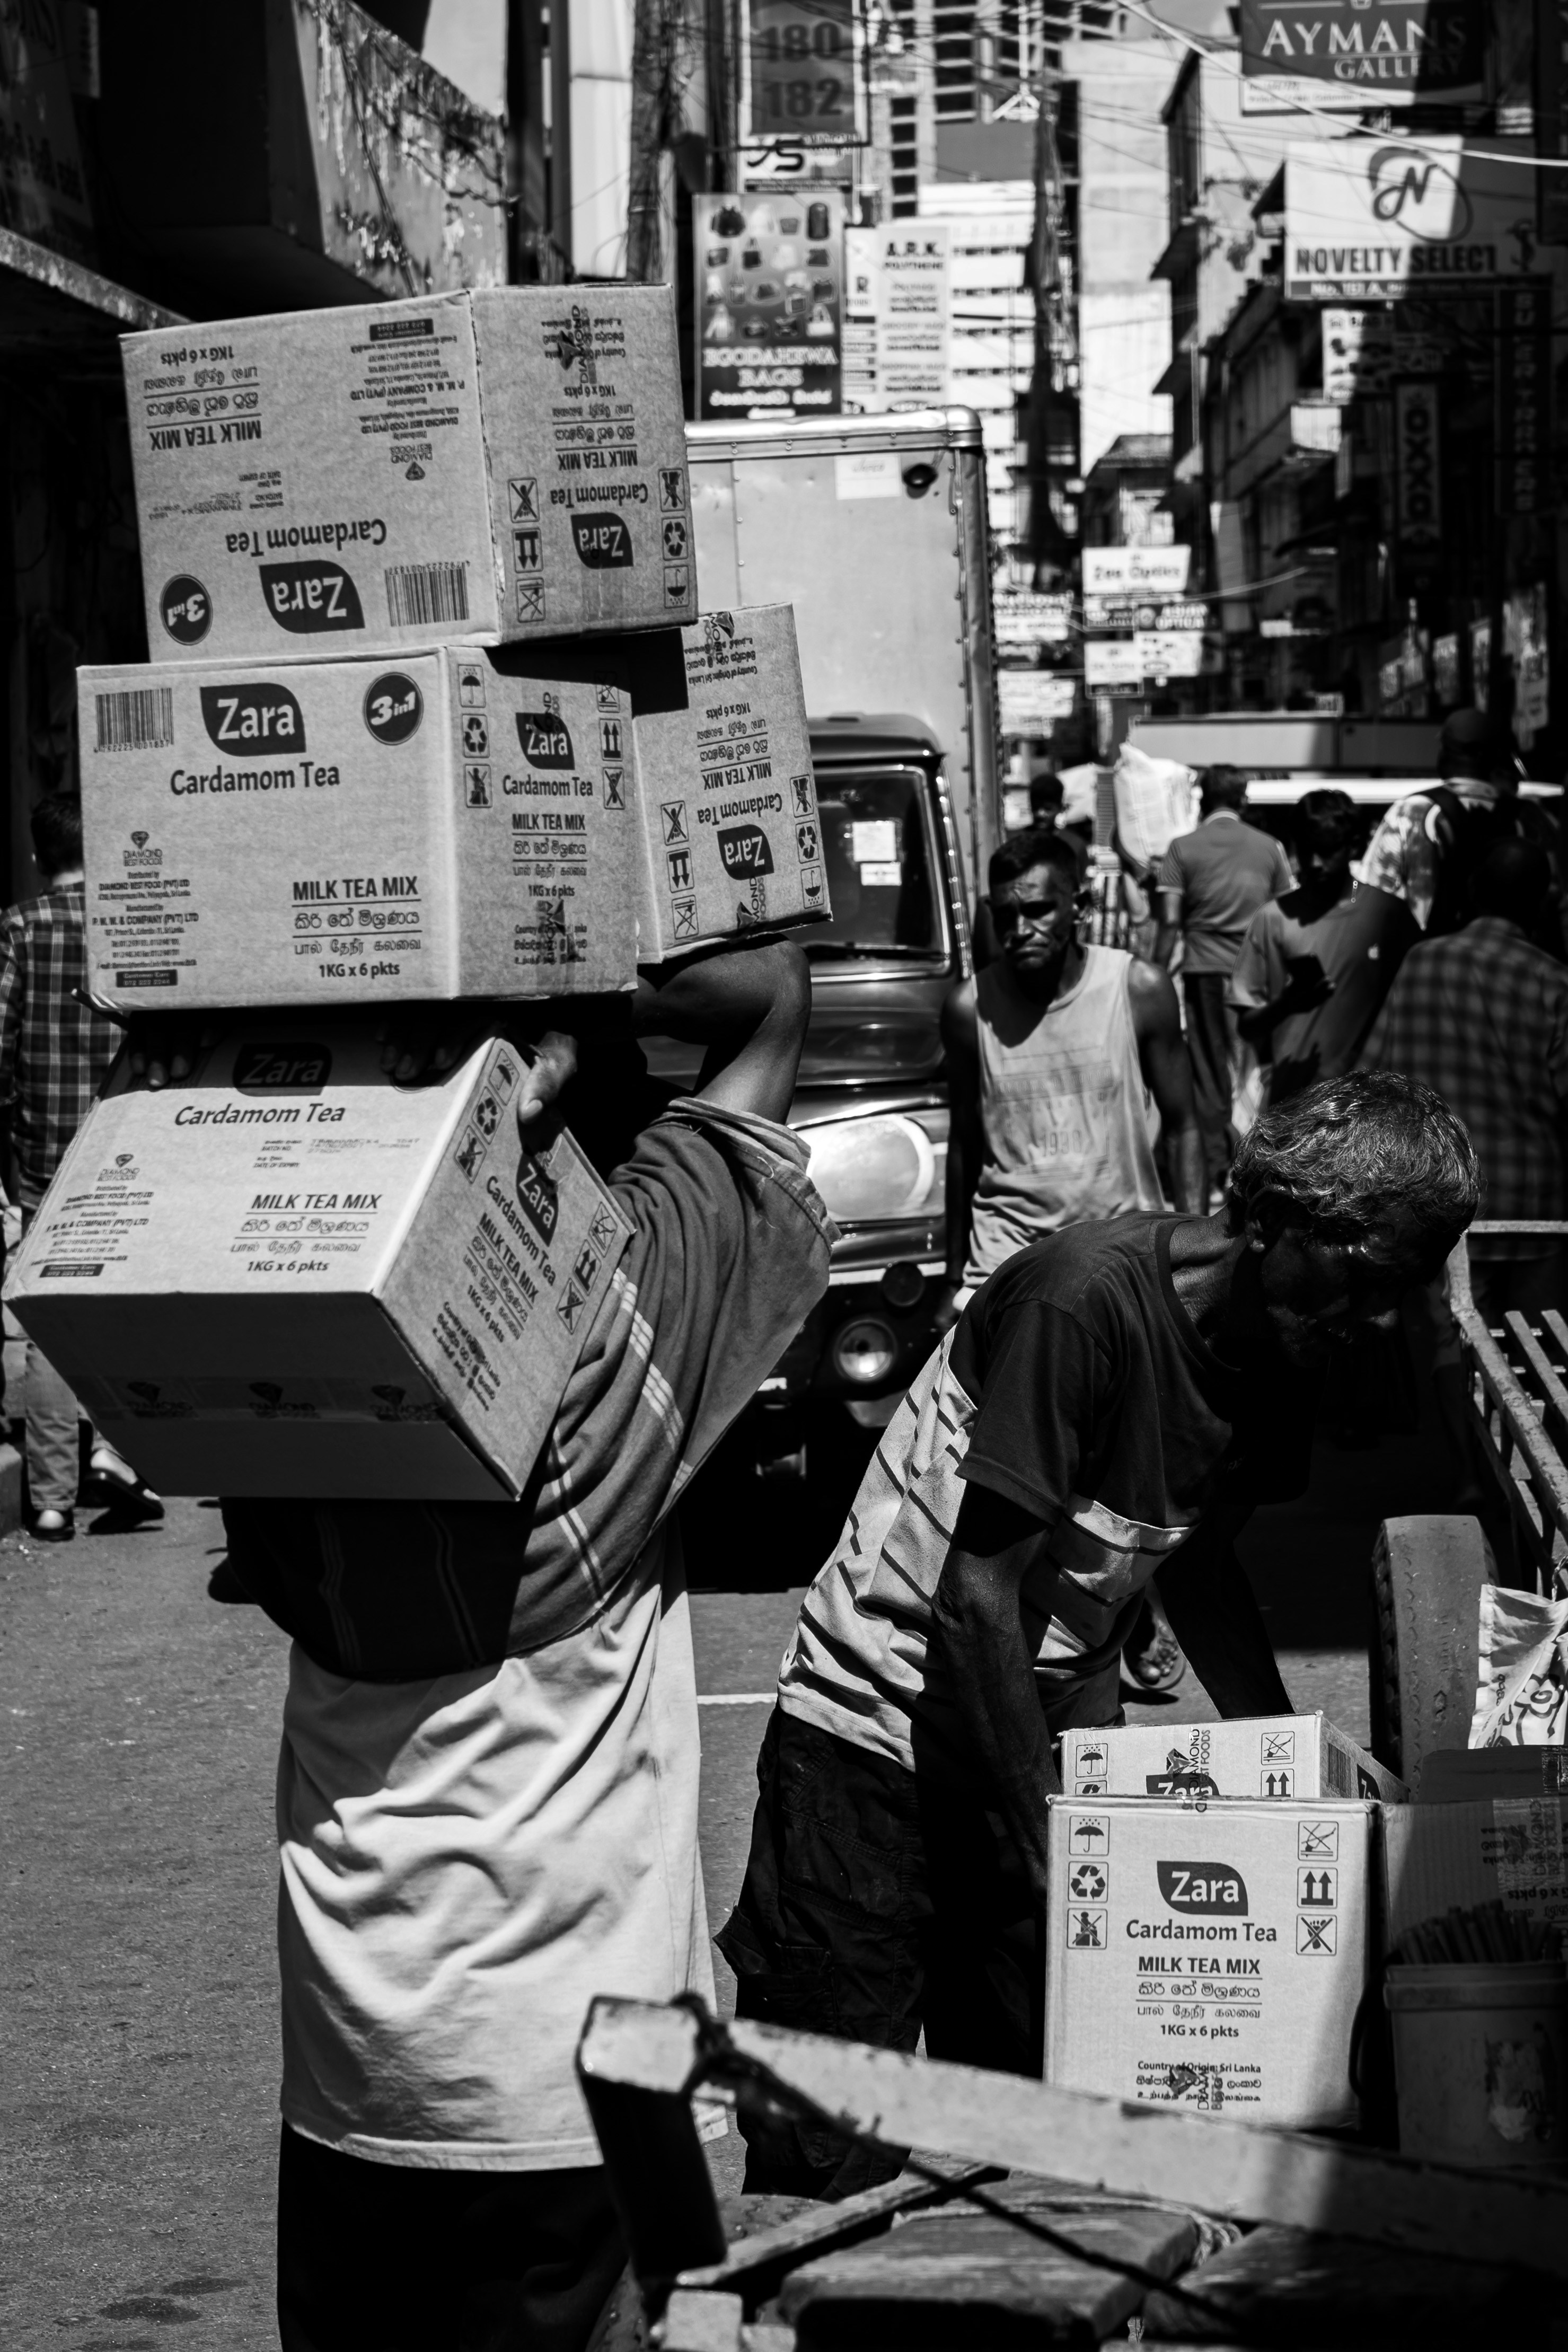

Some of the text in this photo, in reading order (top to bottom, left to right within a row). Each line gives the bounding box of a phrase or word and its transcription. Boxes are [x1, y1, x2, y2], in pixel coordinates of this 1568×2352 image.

[766, 22, 841, 63] 180
[1262, 15, 1467, 56] AYMANS
[1334, 55, 1462, 80] GALLERY
[764, 79, 843, 117] 182
[1297, 245, 1496, 272] NOVELTY SELECT
[160, 345, 234, 367] 1KG x 6 pkts
[385, 383, 426, 397] COMPANY
[738, 368, 804, 387] BAGS
[562, 384, 616, 399] 1KG x 6 pkts
[425, 416, 458, 428] DIAMOND
[148, 419, 261, 451] MILK TEA MIX
[416, 442, 432, 452] BEST
[390, 451, 433, 464] DIAMOND
[557, 449, 637, 471] MILK TEA MIX
[549, 482, 648, 508] Cardamom Tea
[224, 518, 386, 557] Cardamom Tea
[577, 525, 623, 557] Zara
[270, 575, 347, 618] Zara
[166, 593, 205, 626] 3in1
[688, 674, 704, 688] Lanka
[730, 668, 737, 679] of
[736, 662, 757, 678] Country
[217, 698, 295, 741] Zara
[371, 691, 416, 726] 3in1
[705, 701, 751, 719] 1KG x 6 pkts
[526, 723, 568, 756] Zara
[170, 761, 340, 796] Cardamom Tea
[502, 774, 593, 797] Cardamom Tea
[701, 761, 771, 790] MILK TEA MIX
[696, 792, 782, 826] Cardamom Tea
[512, 813, 586, 831] MILK TEA MIX
[123, 848, 162, 859] DIAMOND
[723, 835, 764, 867] Zara
[293, 876, 419, 901] MILK TEA MIX
[528, 884, 575, 899] 1KG x 6 pkts
[319, 961, 401, 980] 1KG x 6 pkts
[242, 1053, 325, 1085] Zara
[174, 1103, 346, 1126] Cardamom Tea
[251, 1194, 382, 1209] MILK TEA MIX
[518, 1162, 555, 1229] Zara
[486, 1176, 556, 1287] Cardamom Tea
[248, 1261, 275, 1272] 1KG
[287, 1261, 297, 1271] 6
[297, 1260, 329, 1274] pkts
[479, 1212, 539, 1304] MILK TEA MIX
[467, 1285, 505, 1344] 1KG x 6 pkts
[1200, 1729, 1211, 1765] FOODS
[1171, 1871, 1240, 1904] Zara
[1508, 1887, 1537, 1901] pkts
[1126, 1918, 1278, 1943] Cardamom Tea
[1139, 1957, 1261, 1974] MILK TEA MIX
[1161, 2025, 1239, 2040] 1KG x 6 pkts
[1138, 2061, 1174, 2072] Country
[1220, 2063, 1231, 2073] Sri
[1234, 2064, 1261, 2073] Lanka
